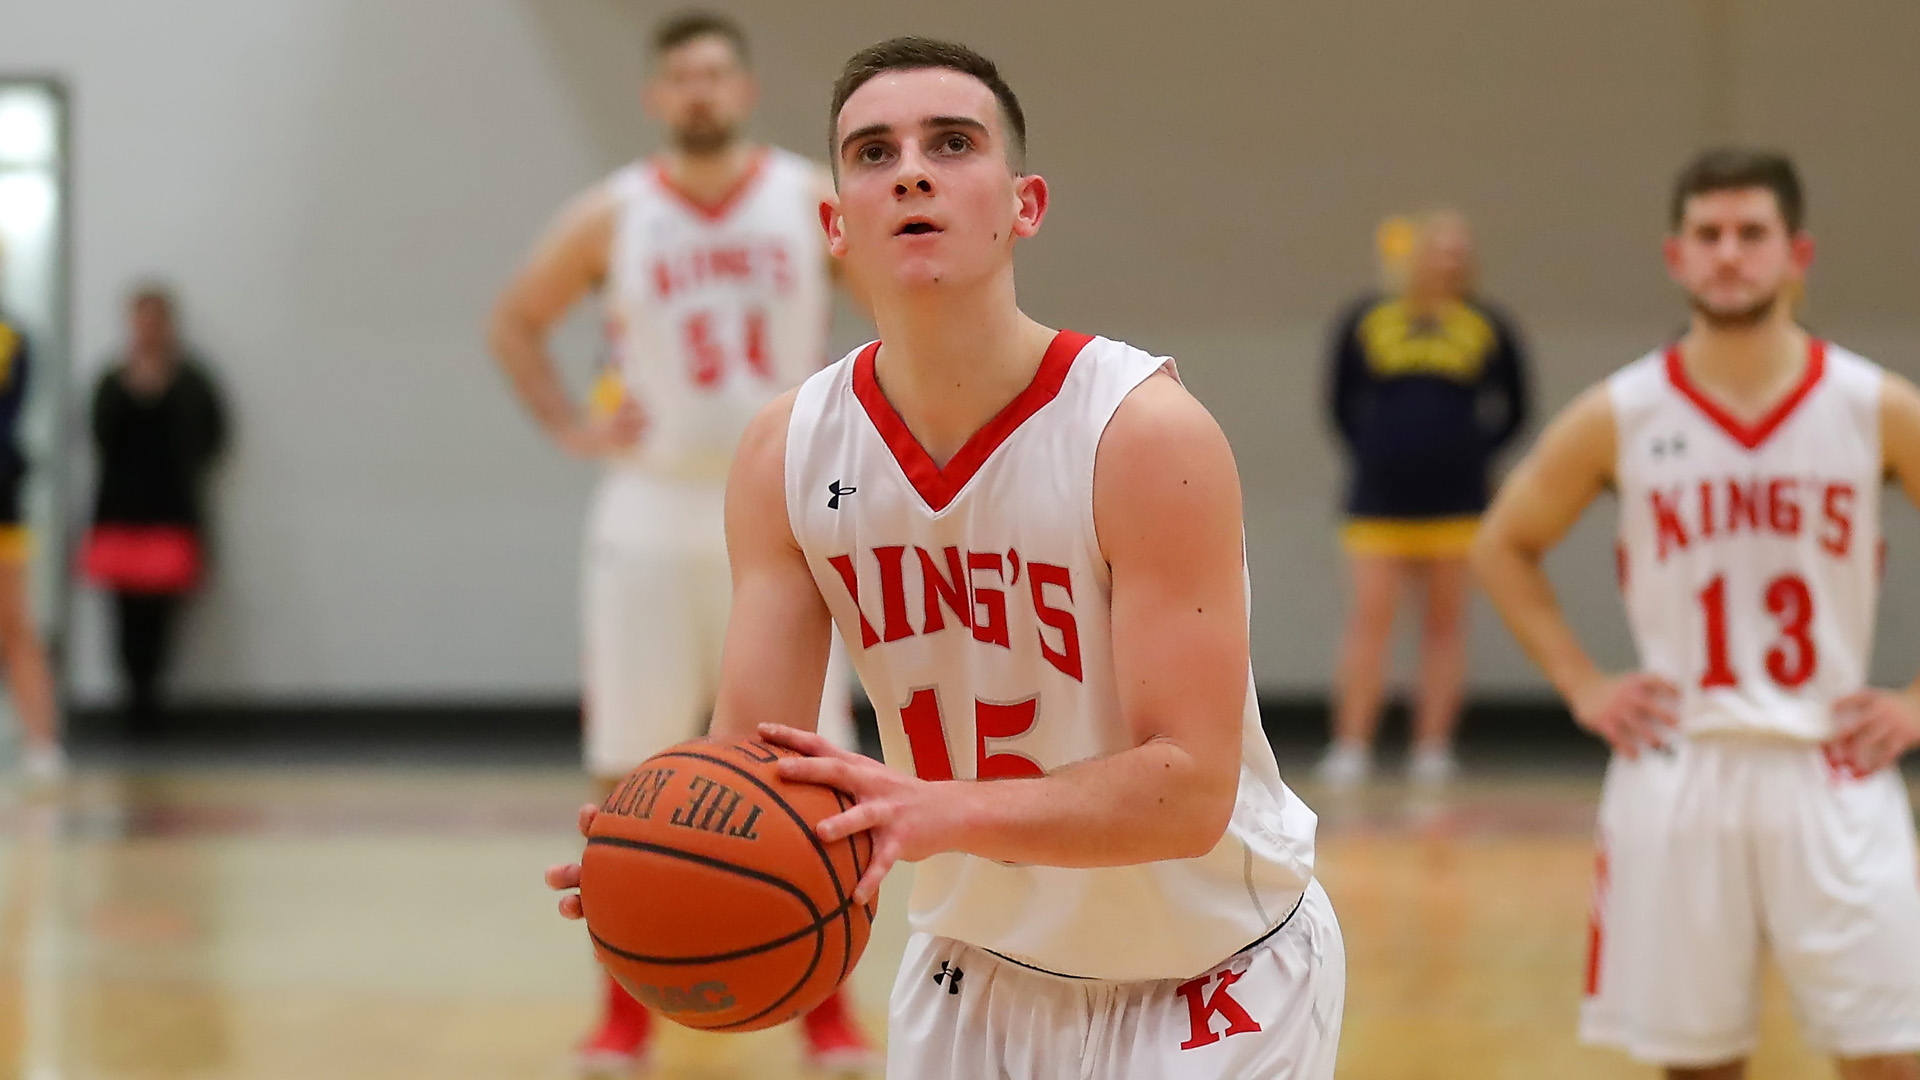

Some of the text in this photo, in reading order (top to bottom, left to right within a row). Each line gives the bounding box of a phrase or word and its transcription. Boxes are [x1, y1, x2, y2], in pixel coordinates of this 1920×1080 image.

[680, 308, 776, 391] 54
[1697, 572, 1818, 690] 13
[899, 683, 1043, 780] 15
[600, 768, 763, 841] THE ROC
[1175, 968, 1262, 1051] K
